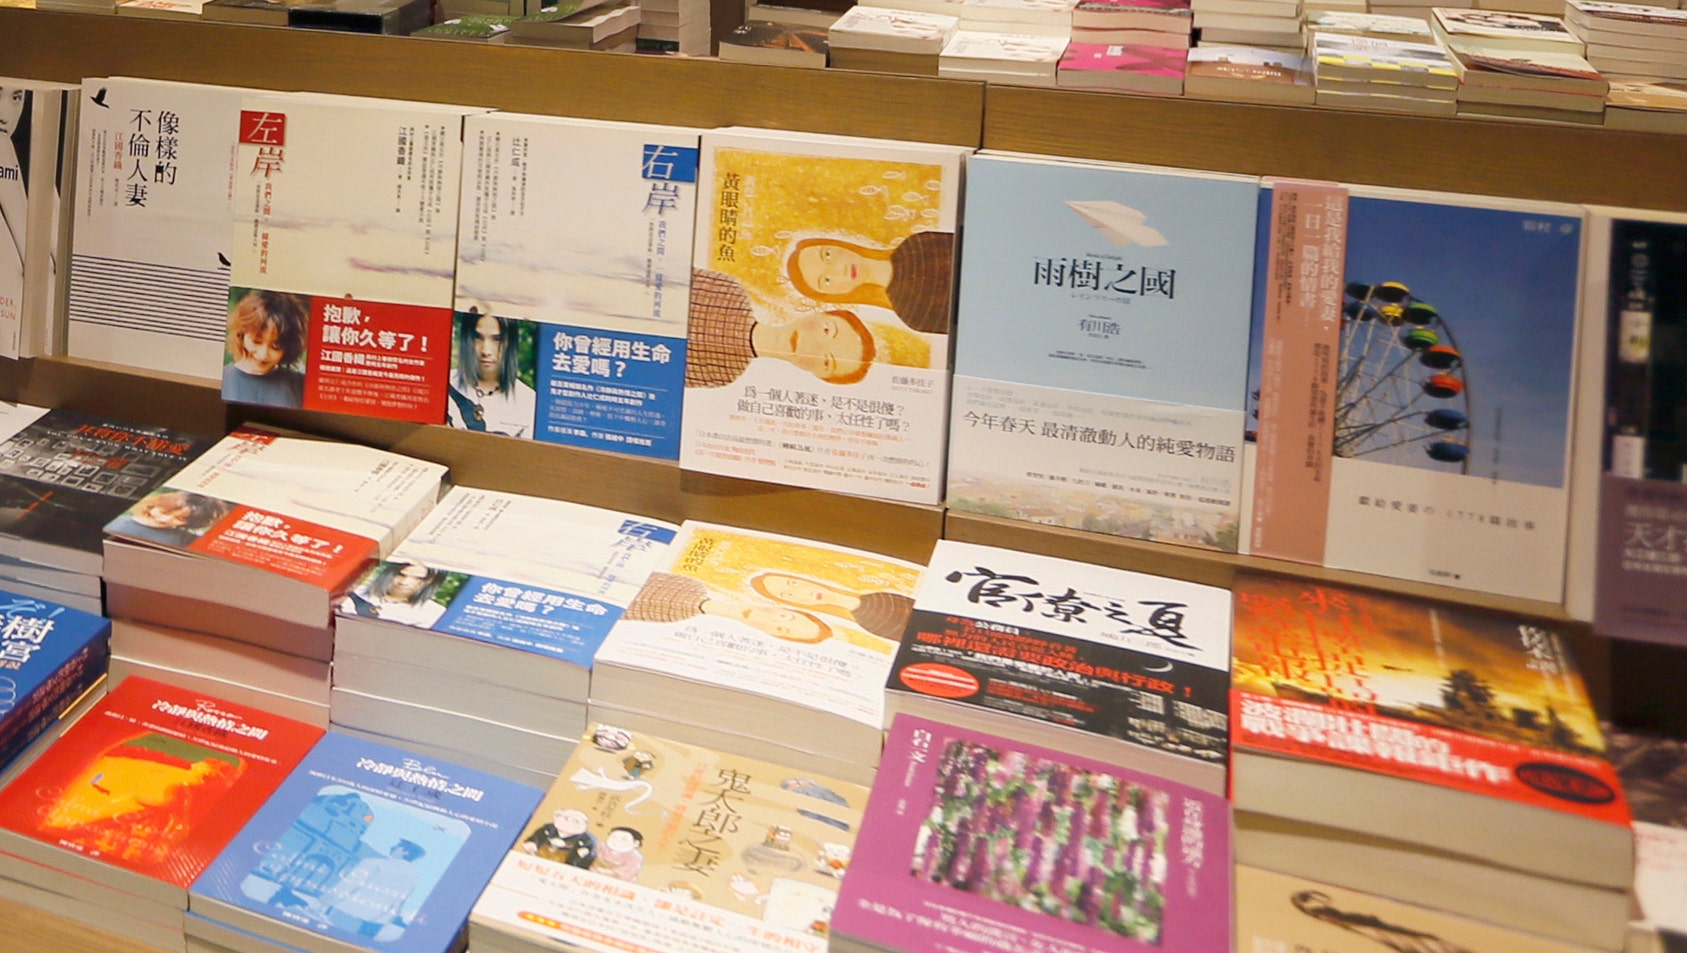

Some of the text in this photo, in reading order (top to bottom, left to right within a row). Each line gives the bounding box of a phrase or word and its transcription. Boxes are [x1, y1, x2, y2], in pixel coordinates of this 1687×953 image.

[125, 109, 152, 208] 不倫人妻
[154, 110, 180, 186] 像樣的
[717, 172, 740, 263] 黃眼睛的魚
[1033, 256, 1177, 300] 雨樹之國
[0, 309, 17, 320] SUN
[323, 304, 371, 326] 抱歉，
[1079, 318, 1121, 336] 有川浩
[322, 325, 428, 353] 讓你久等了！
[552, 352, 627, 378] 去愛嗎？
[963, 410, 1036, 436] 今年春天
[232, 521, 345, 555] 讓你久等了！
[1625, 521, 1687, 548] 天才
[472, 592, 556, 616] 去愛嗎？
[945, 566, 1203, 652] 官僚之夏
[355, 757, 485, 802] 冷靜與熱情之間
[672, 769, 752, 878] 鬼太郎之妻
